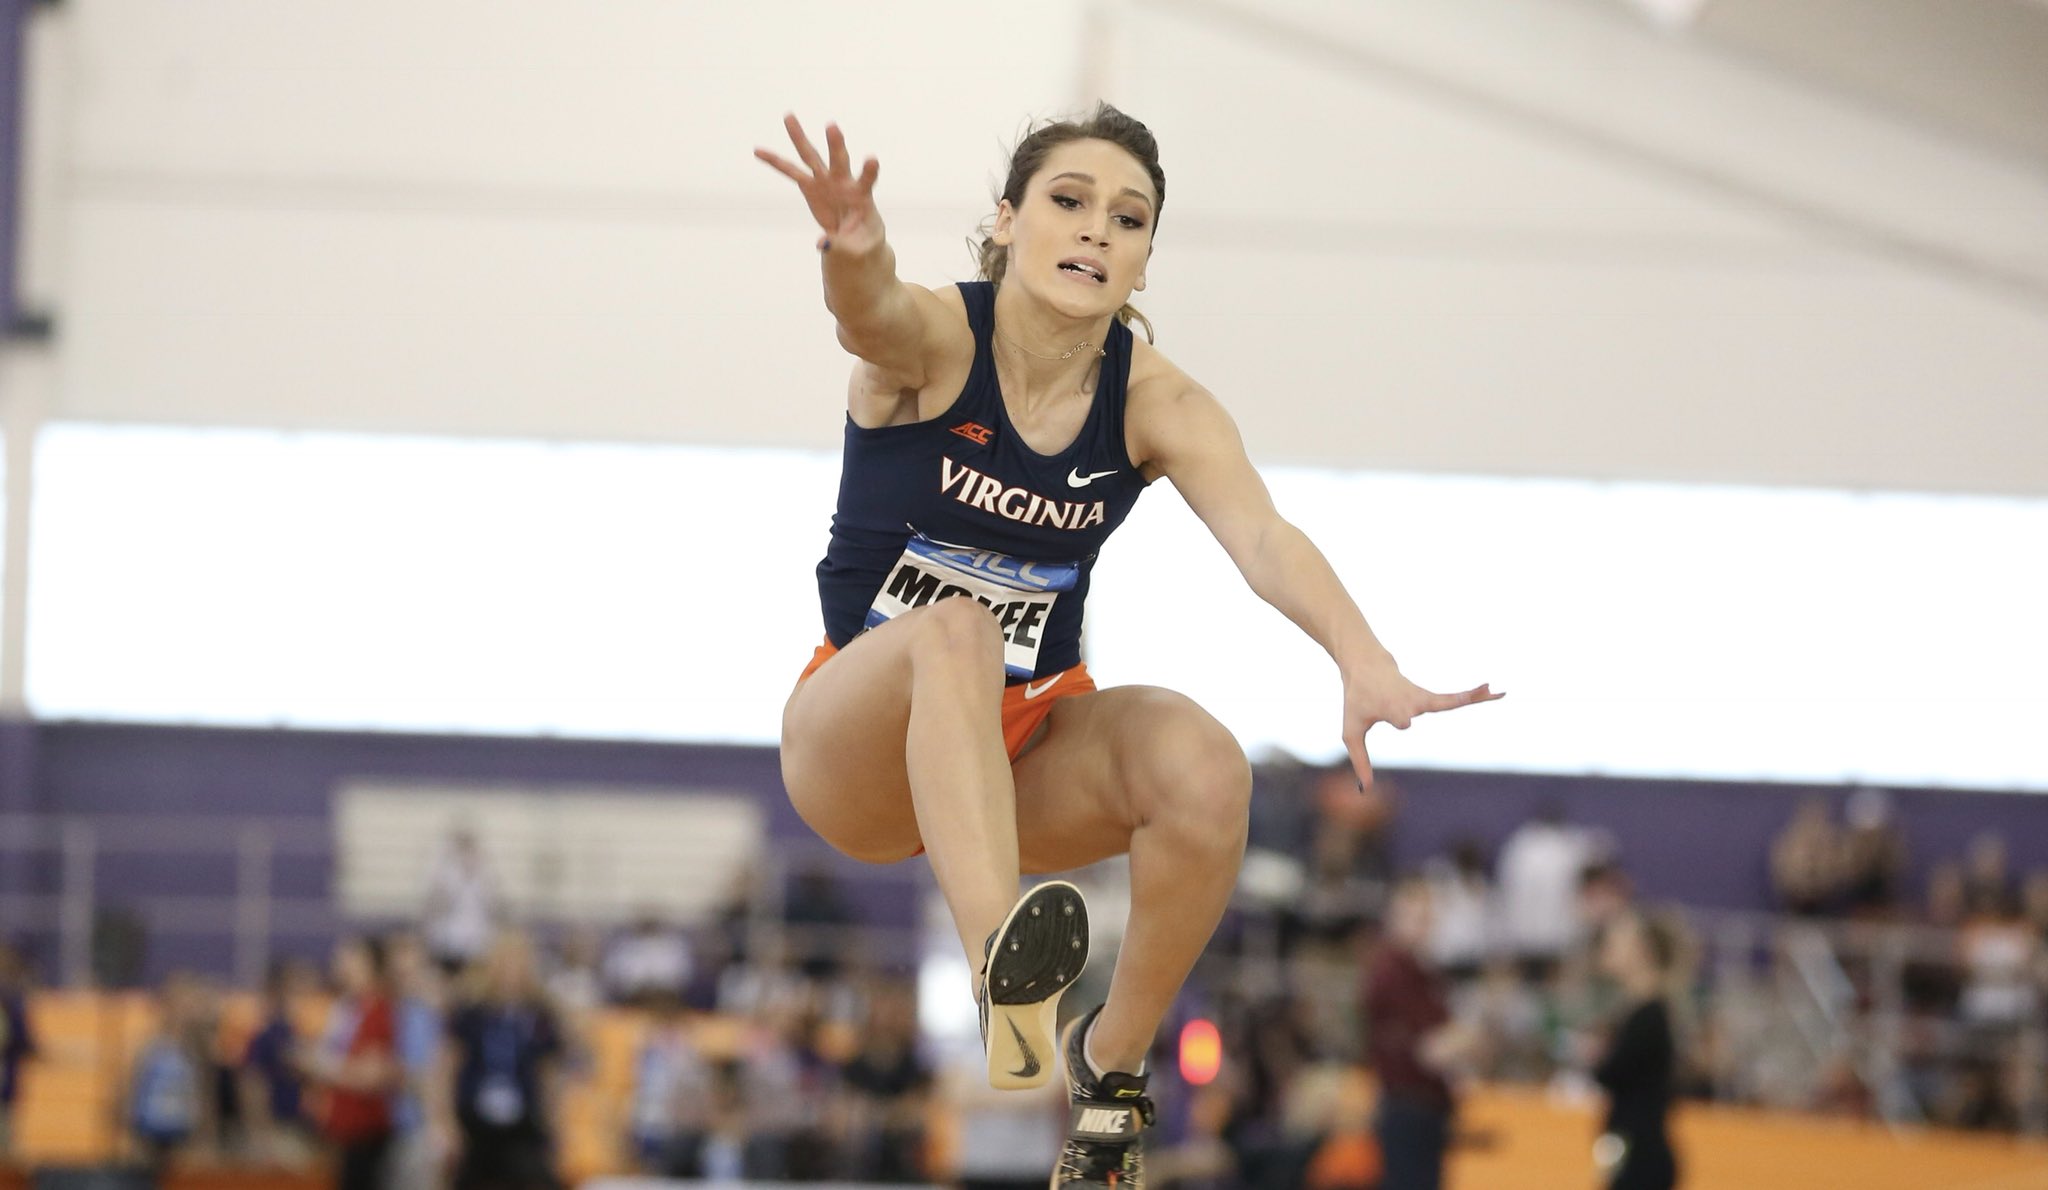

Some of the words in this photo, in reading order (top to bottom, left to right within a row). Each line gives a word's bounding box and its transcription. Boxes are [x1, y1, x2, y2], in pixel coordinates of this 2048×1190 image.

[950, 422, 993, 444] ACC
[941, 456, 1105, 530] VIRGINIA
[1076, 1108, 1130, 1133] NIKE
